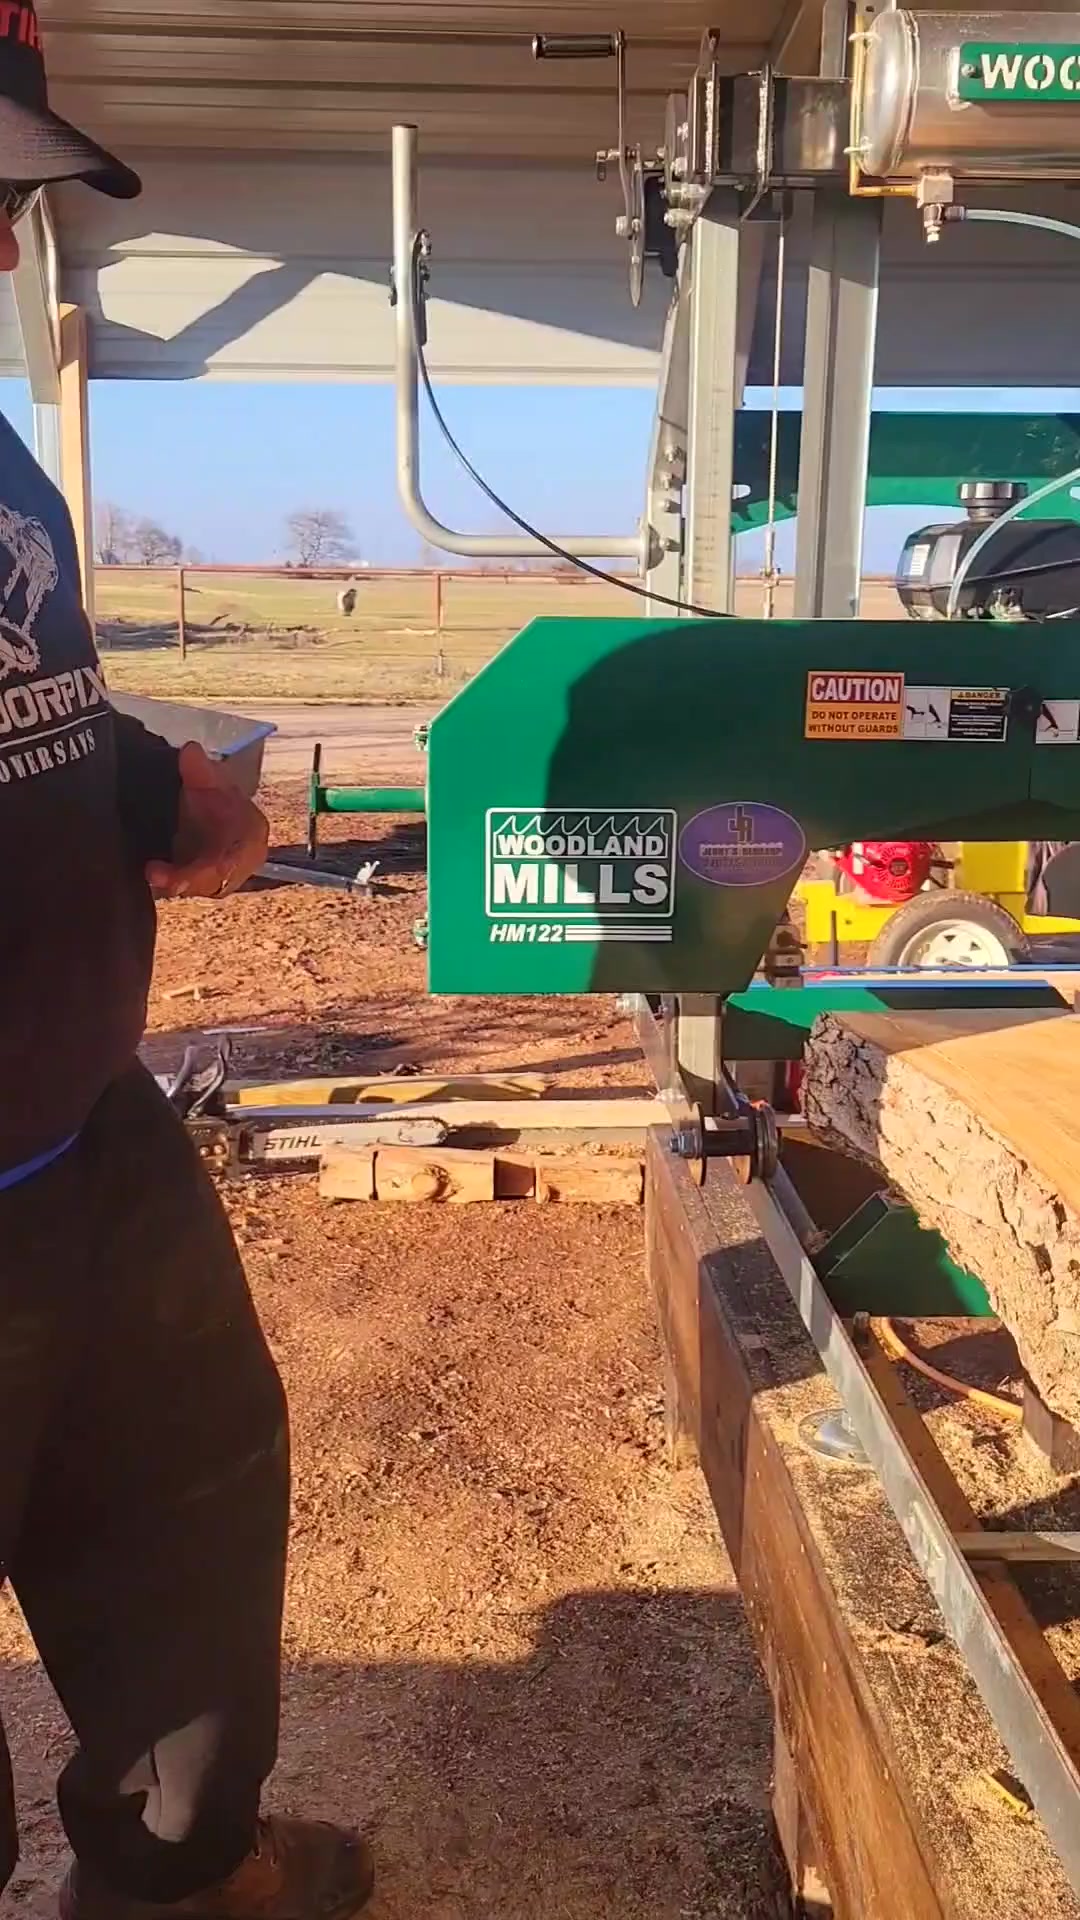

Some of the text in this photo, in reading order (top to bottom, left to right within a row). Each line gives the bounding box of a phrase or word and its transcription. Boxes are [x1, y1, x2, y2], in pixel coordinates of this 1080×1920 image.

[811, 677, 900, 702] CAUTION
[965, 691, 1001, 699] DANGER
[811, 711, 897, 722] DO NOT OPERATE
[808, 723, 899, 734] WITHOUT GUARDS
[498, 835, 665, 856] WOODLAND
[493, 863, 669, 905] MILLS
[489, 924, 565, 943] HM122
[264, 1135, 323, 1151] STIHL
